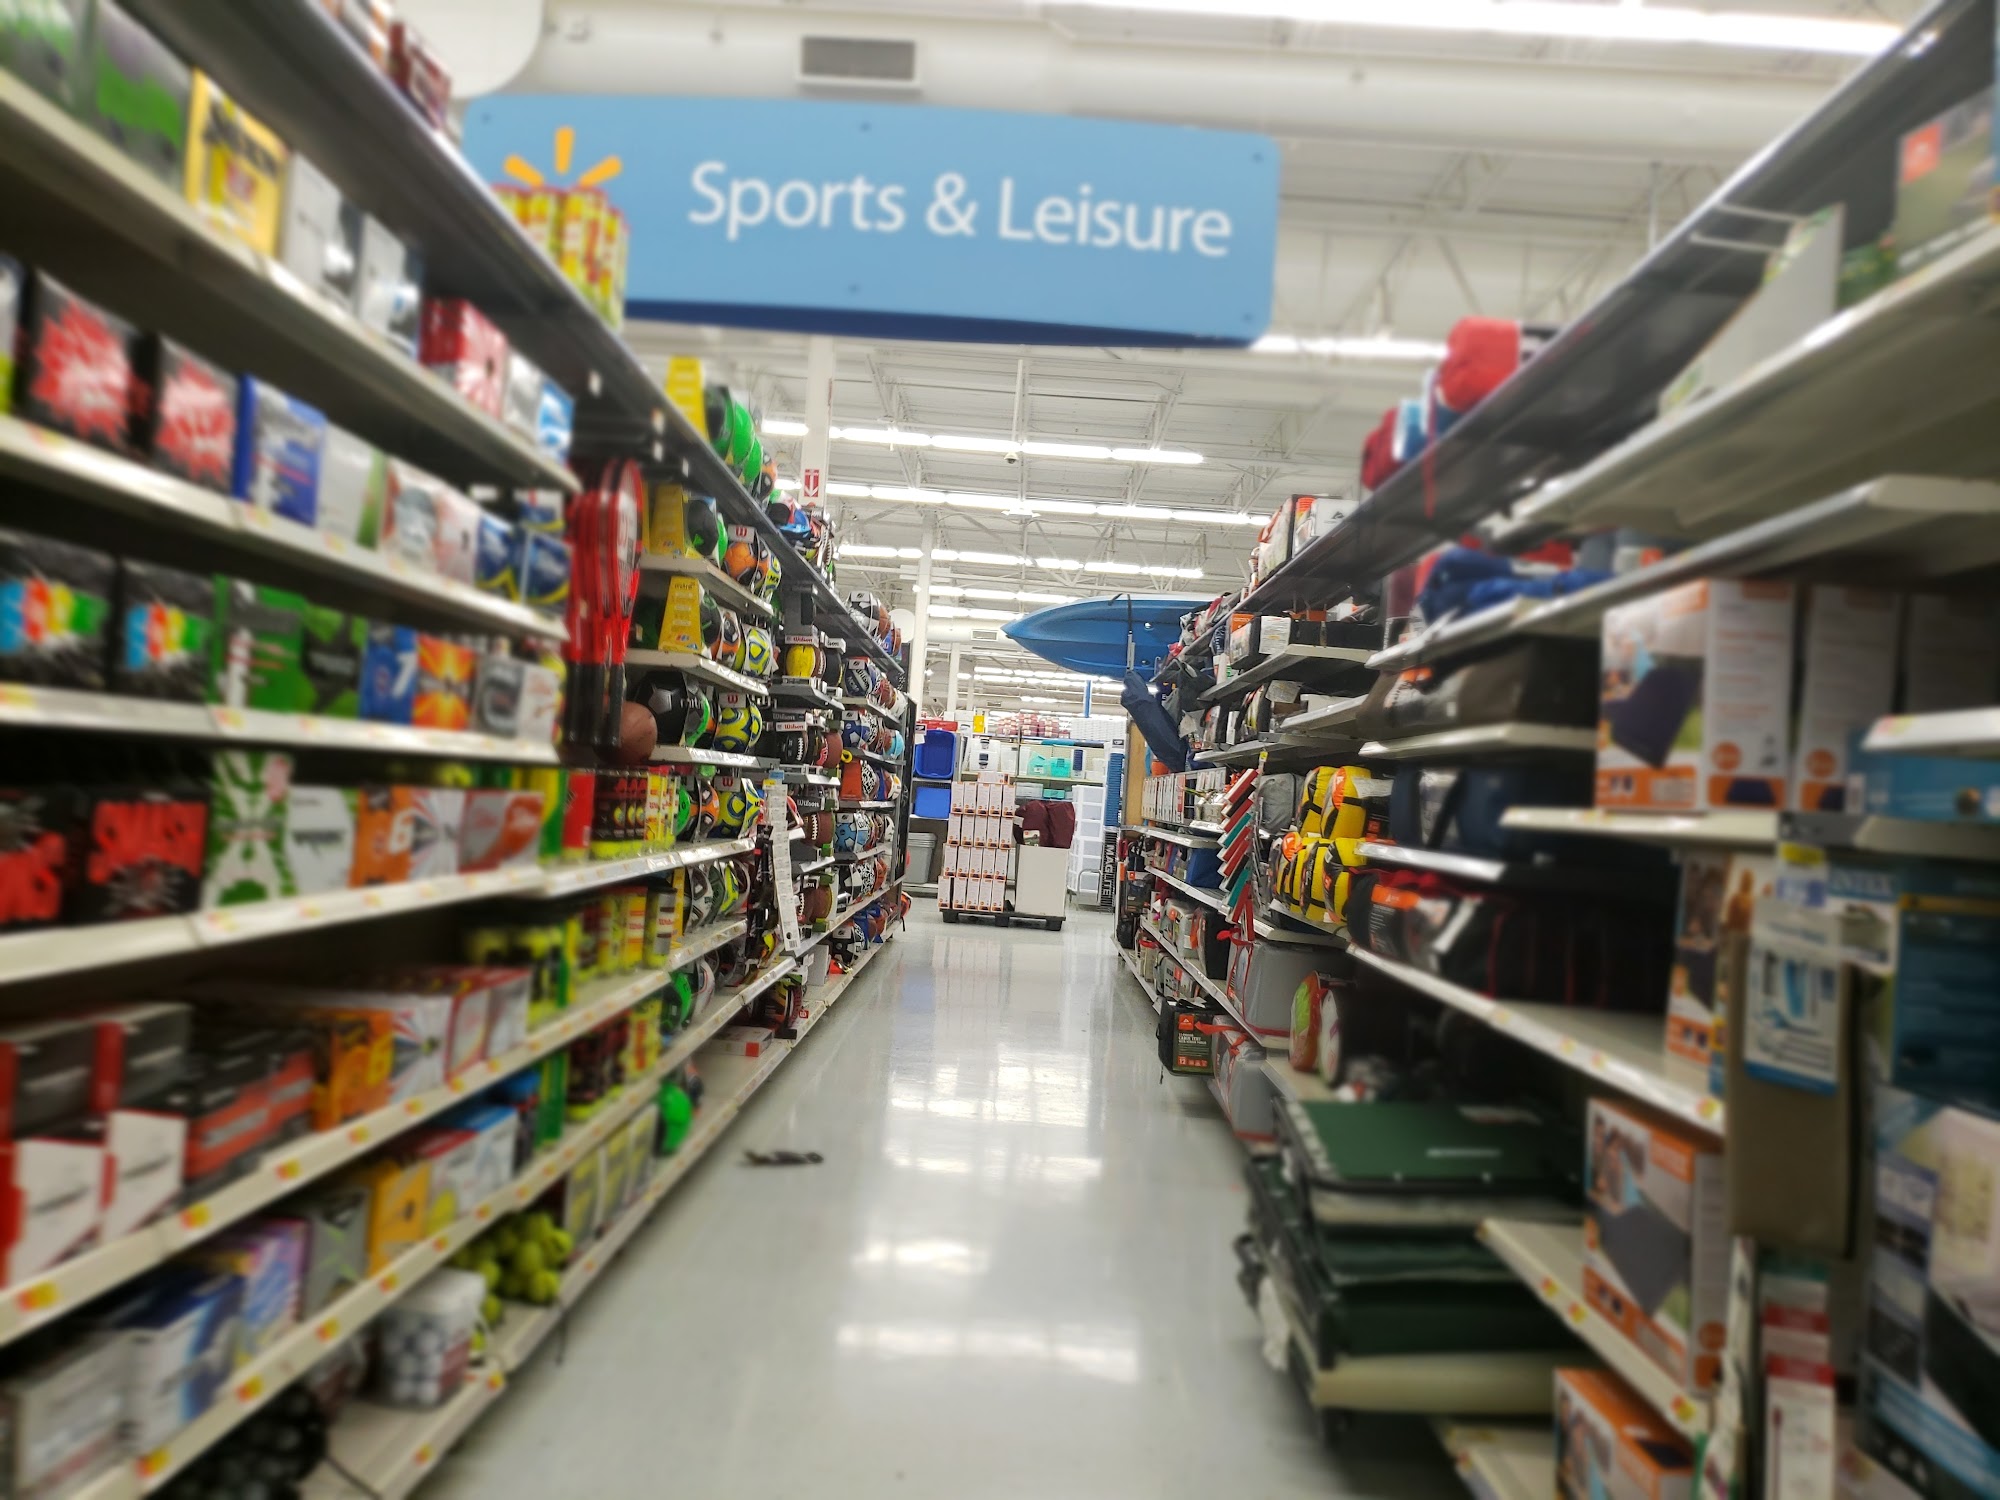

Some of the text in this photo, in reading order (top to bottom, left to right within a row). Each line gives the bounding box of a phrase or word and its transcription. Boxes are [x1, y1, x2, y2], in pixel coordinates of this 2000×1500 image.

[688, 160, 1233, 258] Sports & Leisure
[796, 799, 820, 808] Wilson
[1102, 844, 1116, 897] MAGLITE
